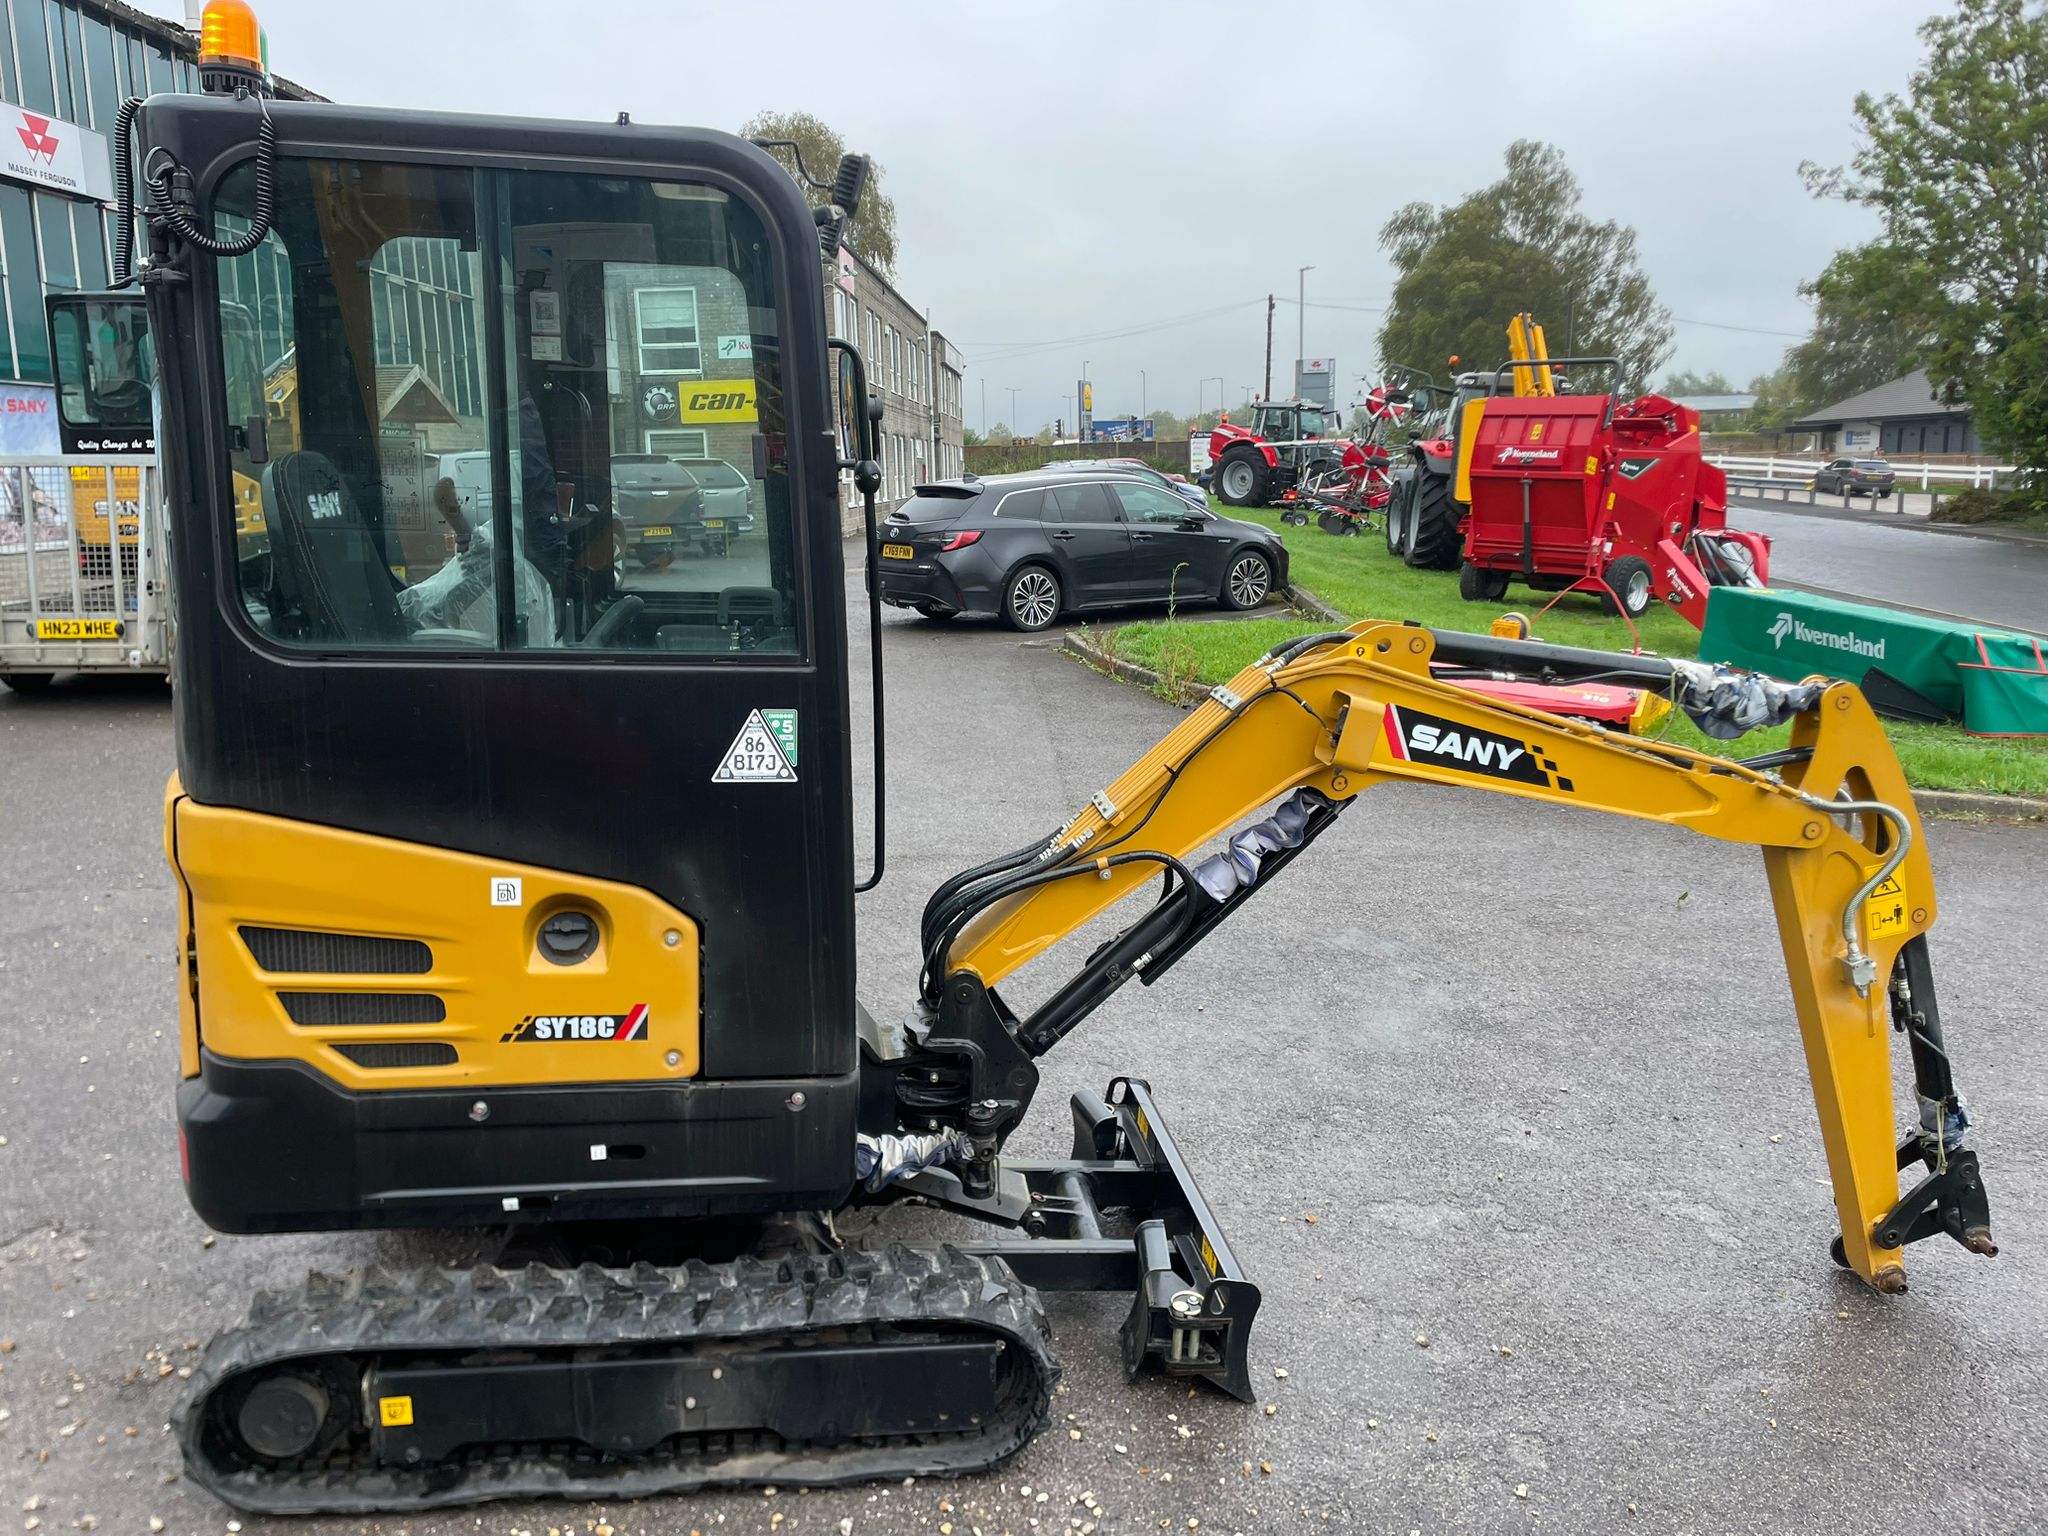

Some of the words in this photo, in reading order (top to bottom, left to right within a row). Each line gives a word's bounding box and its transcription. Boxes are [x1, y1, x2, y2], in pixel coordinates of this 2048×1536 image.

[8, 162, 38, 177] MASSEY
[40, 171, 77, 188] FERGUSON
[7, 399, 47, 414] SANY
[77, 440, 99, 451] Quality
[102, 440, 128, 451] Changes
[131, 440, 142, 449] the
[884, 546, 898, 556] CV69
[43, 622, 80, 635] HN23
[84, 622, 112, 635] WHE
[1794, 620, 1886, 660] Kverneland
[782, 719, 794, 734] 5
[745, 736, 765, 753] 86
[1408, 724, 1526, 771] SANY
[535, 1016, 615, 1039] SY18C
